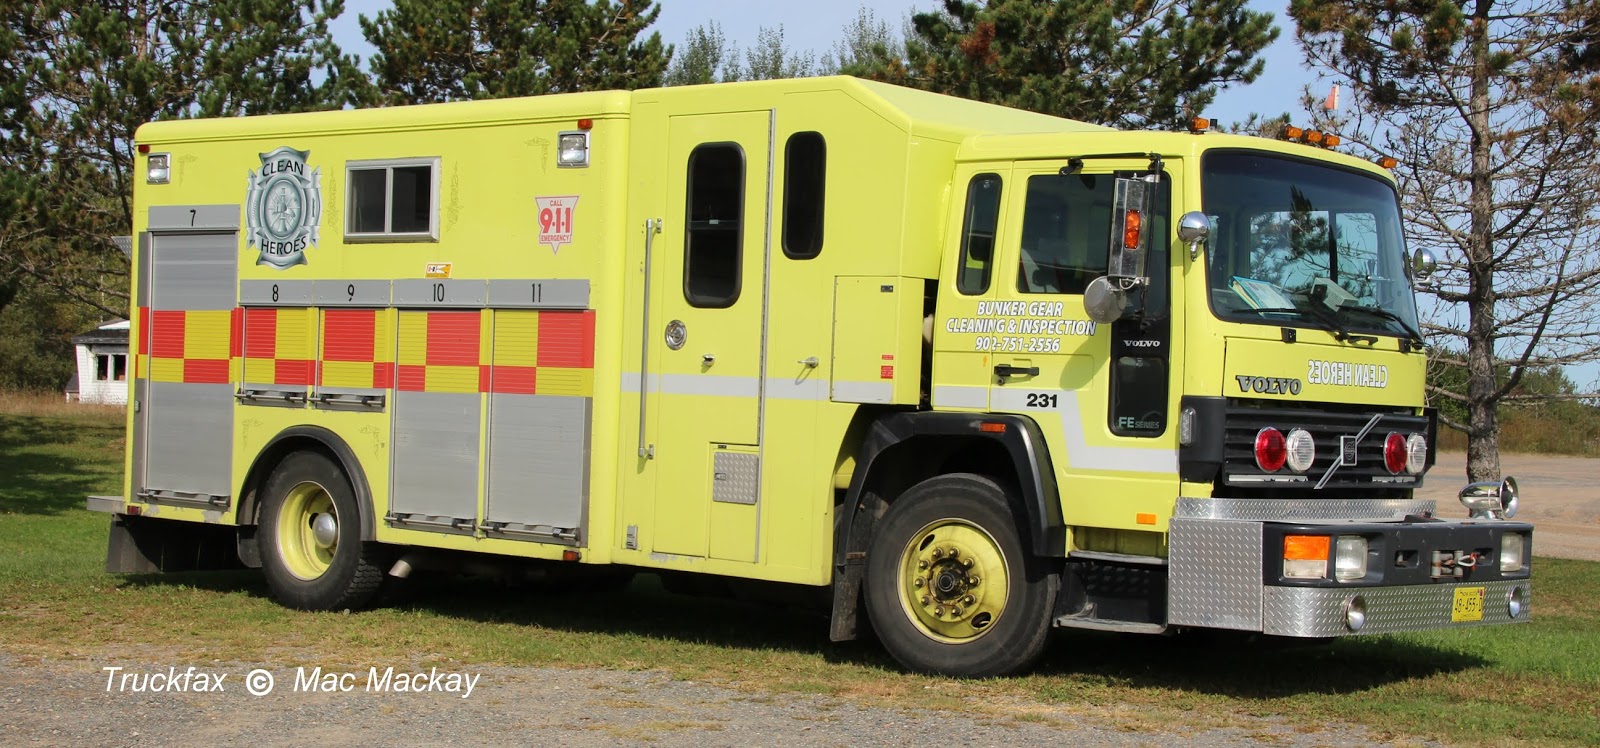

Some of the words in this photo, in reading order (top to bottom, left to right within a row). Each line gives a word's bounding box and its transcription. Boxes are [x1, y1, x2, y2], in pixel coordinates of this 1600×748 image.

[262, 160, 304, 177] CLEAN
[190, 209, 197, 227] 7
[261, 236, 306, 255] HEROES
[541, 234, 570, 242] EMERGENCY
[272, 284, 279, 302] 8
[347, 284, 355, 302] 9
[433, 283, 445, 302] 10
[531, 283, 542, 303] 11
[977, 301, 1027, 316] BUNKER
[1028, 301, 1064, 317] GEAR
[946, 318, 1005, 333] CLEANING
[1007, 320, 1018, 334] &
[1018, 319, 1097, 336] INSPECTION
[975, 336, 1061, 352] 902-751-2556
[1123, 339, 1161, 347] VOLVO
[1235, 375, 1302, 396] VOLVO
[1026, 392, 1058, 408] 231
[1118, 416, 1135, 429] FE
[1134, 421, 1160, 429] SERIES
